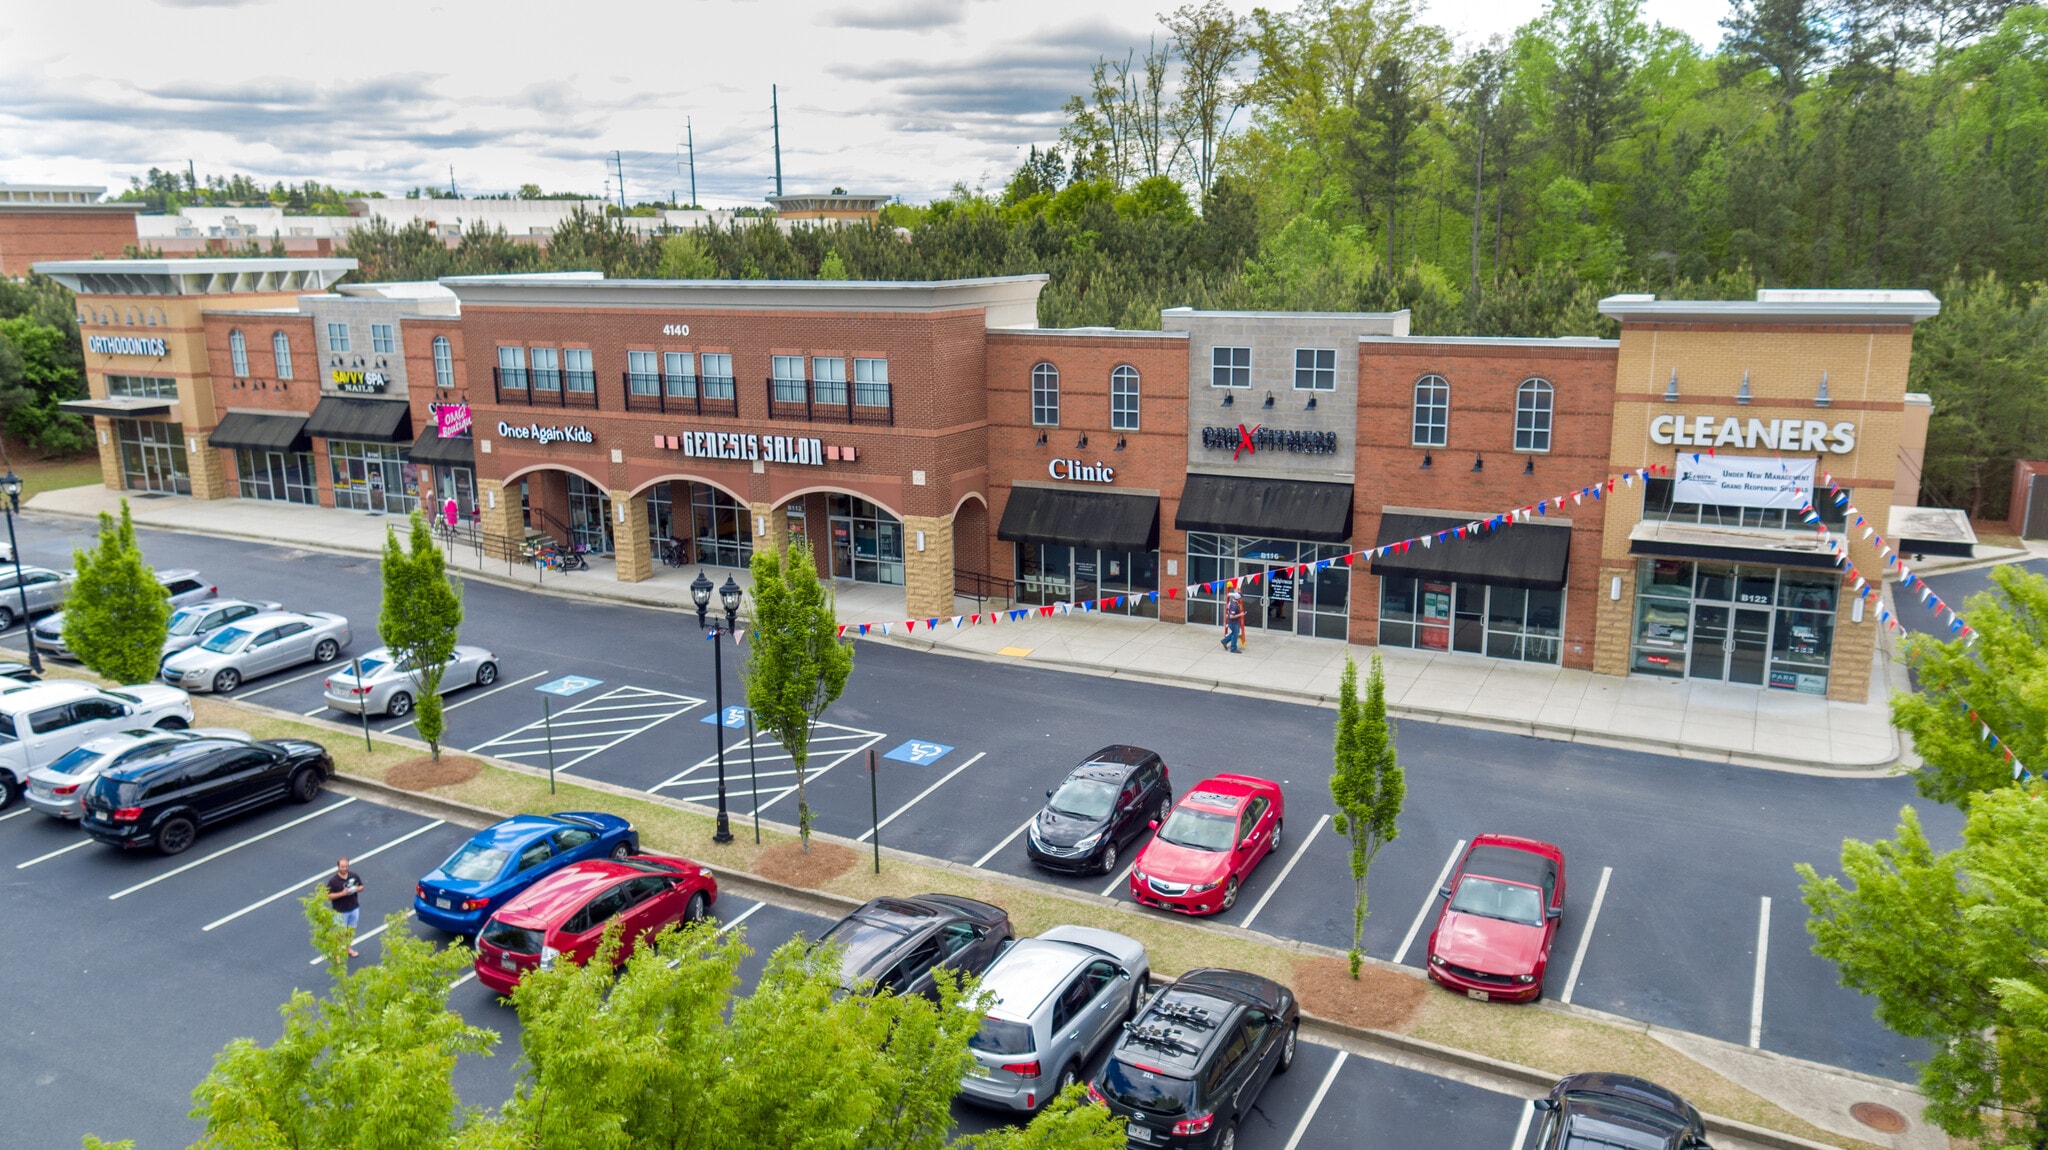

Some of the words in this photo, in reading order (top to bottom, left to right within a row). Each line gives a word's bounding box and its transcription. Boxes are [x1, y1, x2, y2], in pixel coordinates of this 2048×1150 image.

[663, 324, 690, 336] 4140
[89, 335, 168, 356] ORTHODONTICS
[333, 370, 364, 384] SAVVY
[365, 372, 385, 386] SPA
[344, 384, 375, 393] NAILS
[445, 403, 466, 426] OMG!
[498, 421, 530, 439] Once
[531, 423, 564, 445] Again
[565, 425, 592, 443] Kids
[1650, 414, 1856, 454] CLEANERS
[683, 431, 759, 461] GENESIS
[763, 435, 824, 466] SALON
[1048, 457, 1114, 483] Clinic
[1780, 485, 1809, 493] SPECLS
[1741, 593, 1768, 604] B122
[1771, 673, 1795, 681] PARK
